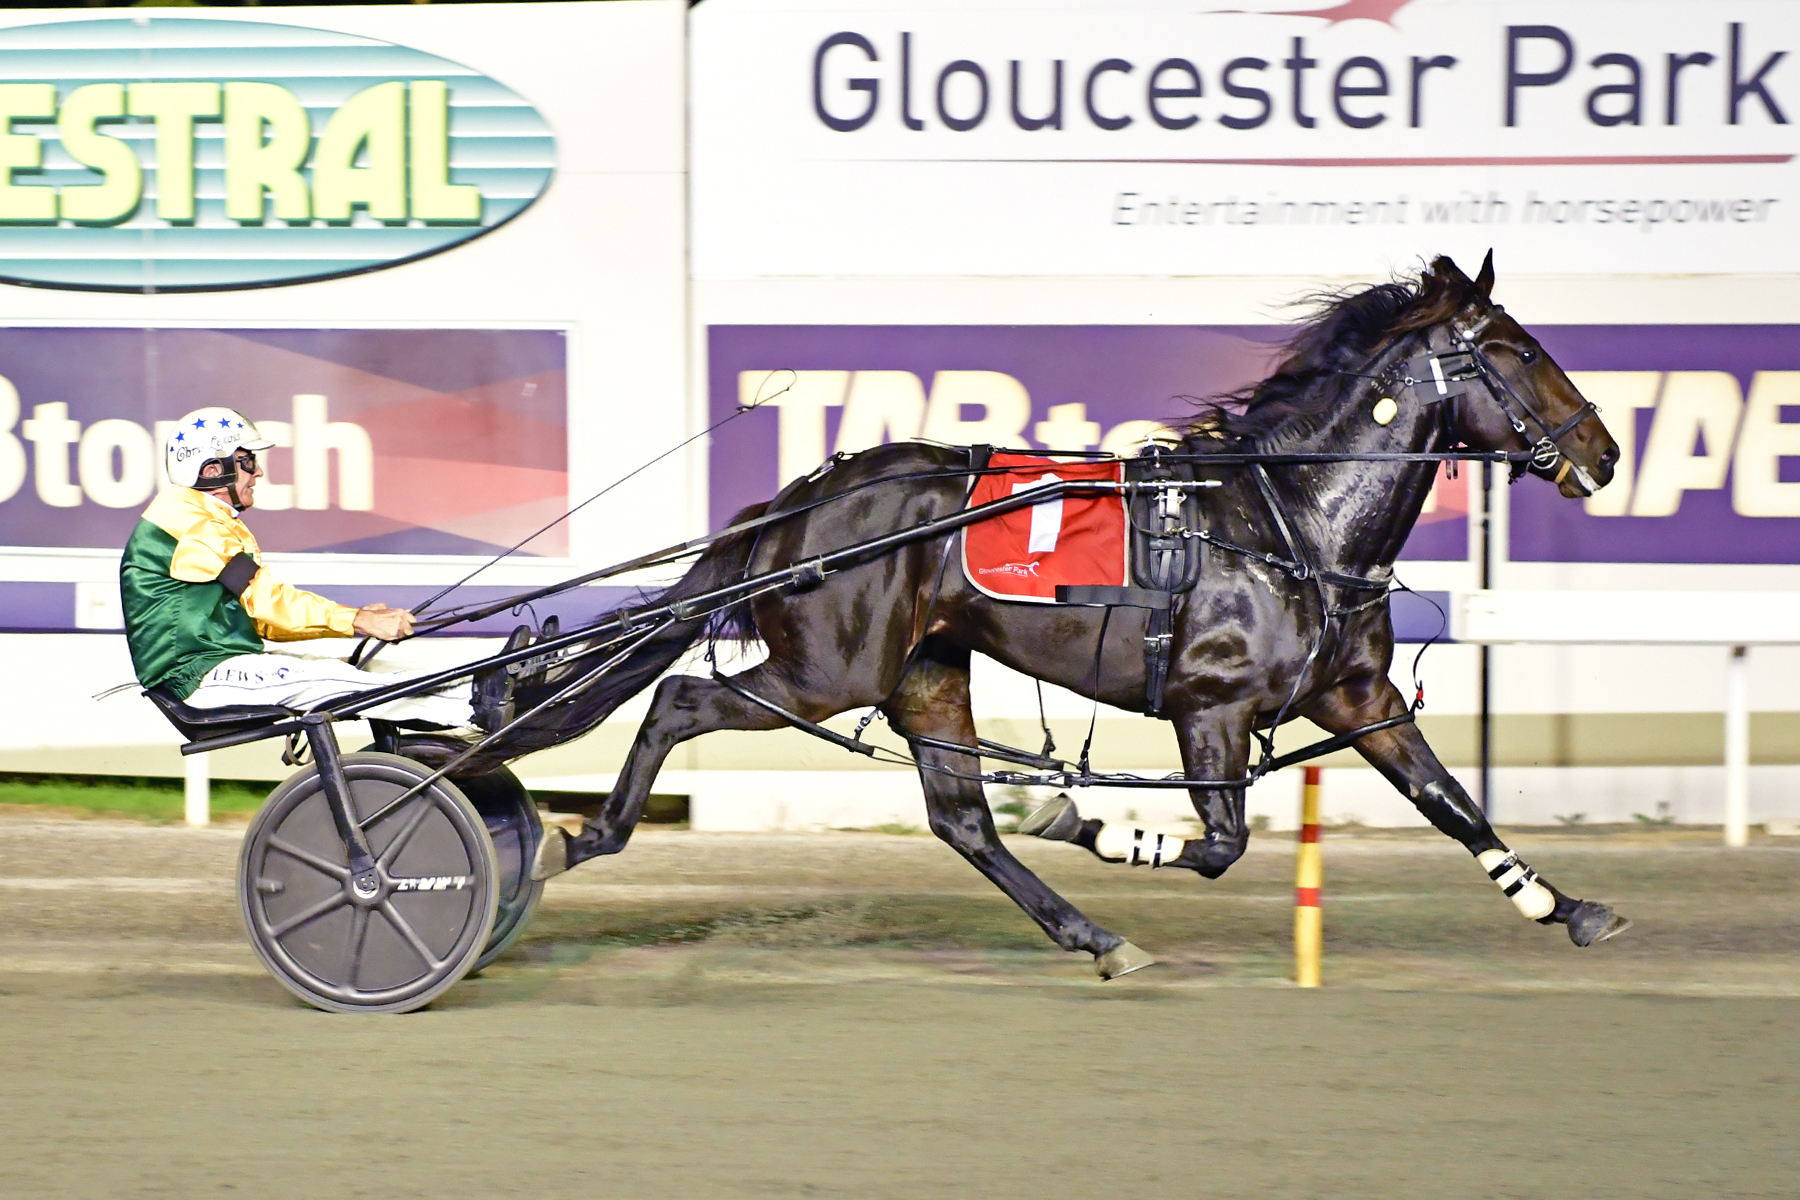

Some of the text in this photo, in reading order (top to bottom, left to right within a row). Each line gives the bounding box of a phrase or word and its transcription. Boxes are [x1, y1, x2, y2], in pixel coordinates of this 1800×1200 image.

[812, 21, 1794, 132] Gloucester Park
[0, 80, 483, 228] ESTRAL
[1111, 190, 1781, 233] Entertainment with horsepower
[1011, 472, 1064, 554] 1
[1013, 566, 1028, 576] Park
